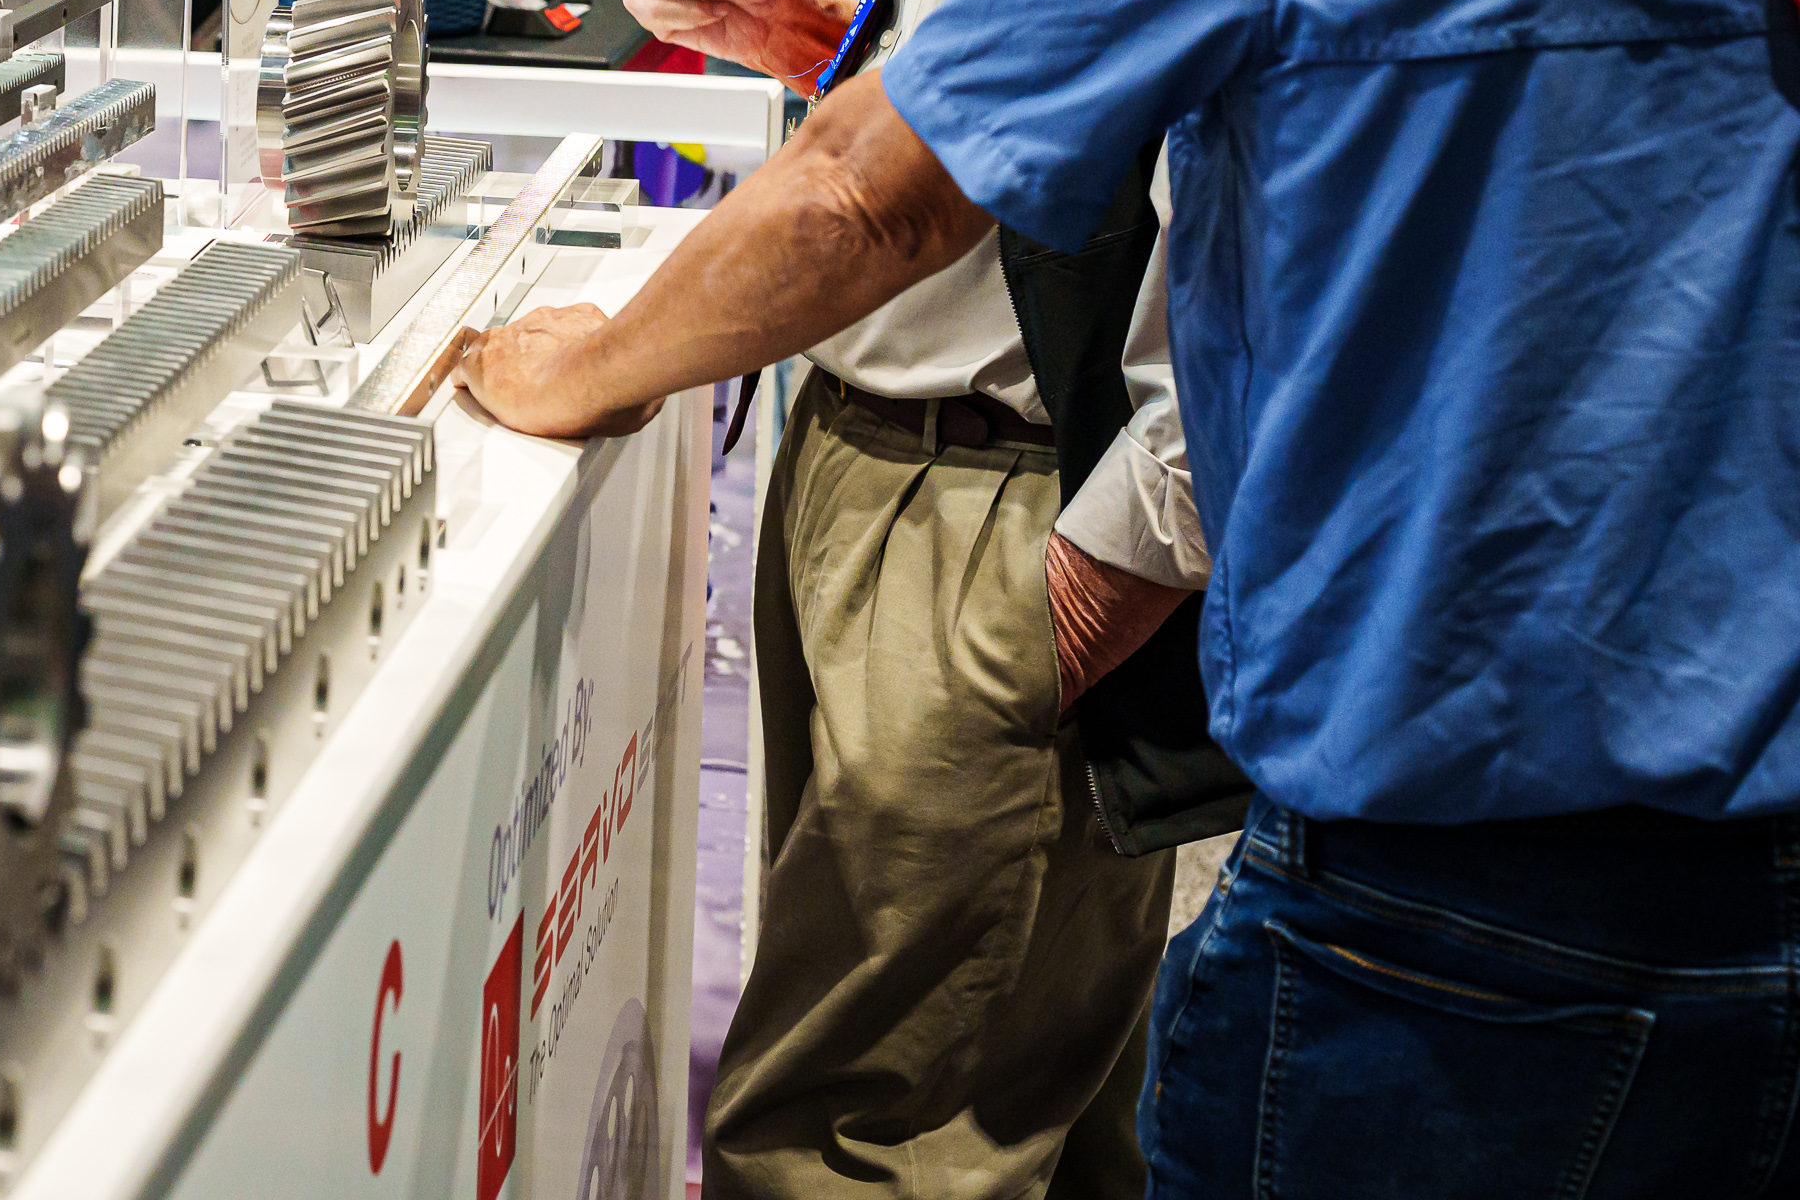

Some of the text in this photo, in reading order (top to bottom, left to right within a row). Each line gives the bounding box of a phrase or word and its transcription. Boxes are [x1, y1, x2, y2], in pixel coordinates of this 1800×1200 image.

[488, 677, 594, 923] Optimized By:
[528, 876, 619, 1104] The Optimal Solution
